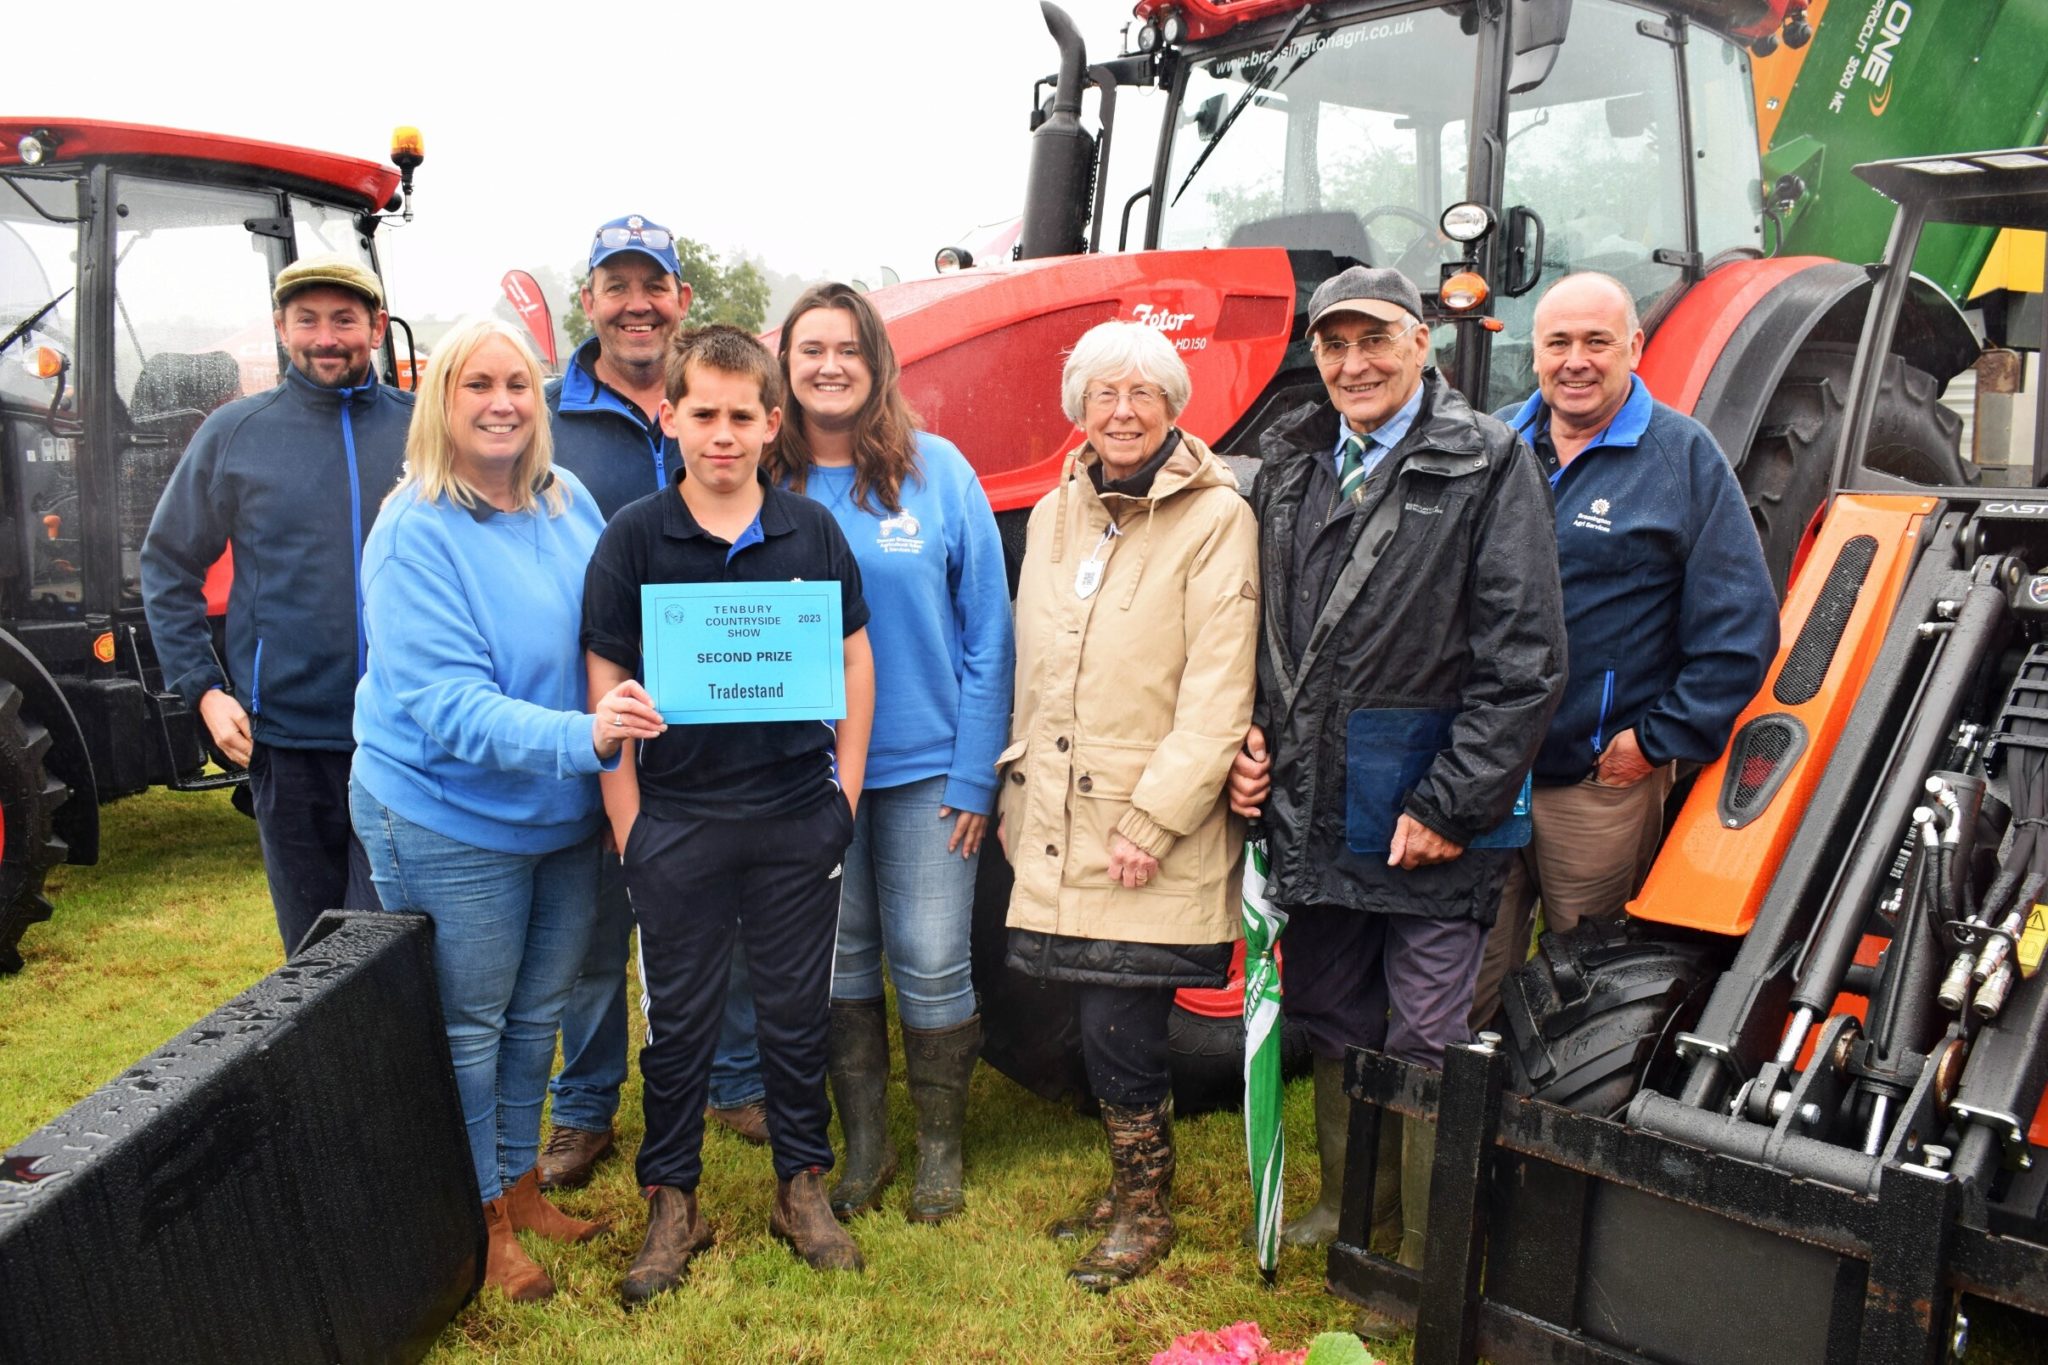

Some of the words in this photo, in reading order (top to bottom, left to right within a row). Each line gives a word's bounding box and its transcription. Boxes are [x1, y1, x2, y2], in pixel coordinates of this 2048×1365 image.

[1216, 17, 1414, 75] www.brasingtonagri.co.uk
[1861, 0, 1912, 88] ONE
[1839, 55, 1861, 89] 3000
[1828, 91, 1846, 114] MC
[714, 605, 773, 614] TENBURY
[705, 616, 781, 627] COUNTRYSIDE
[798, 614, 821, 624] 2023
[727, 628, 761, 638] SHOW
[697, 652, 753, 663] SECOND
[756, 651, 793, 662] PRIZE
[708, 681, 784, 700] Tradestand
